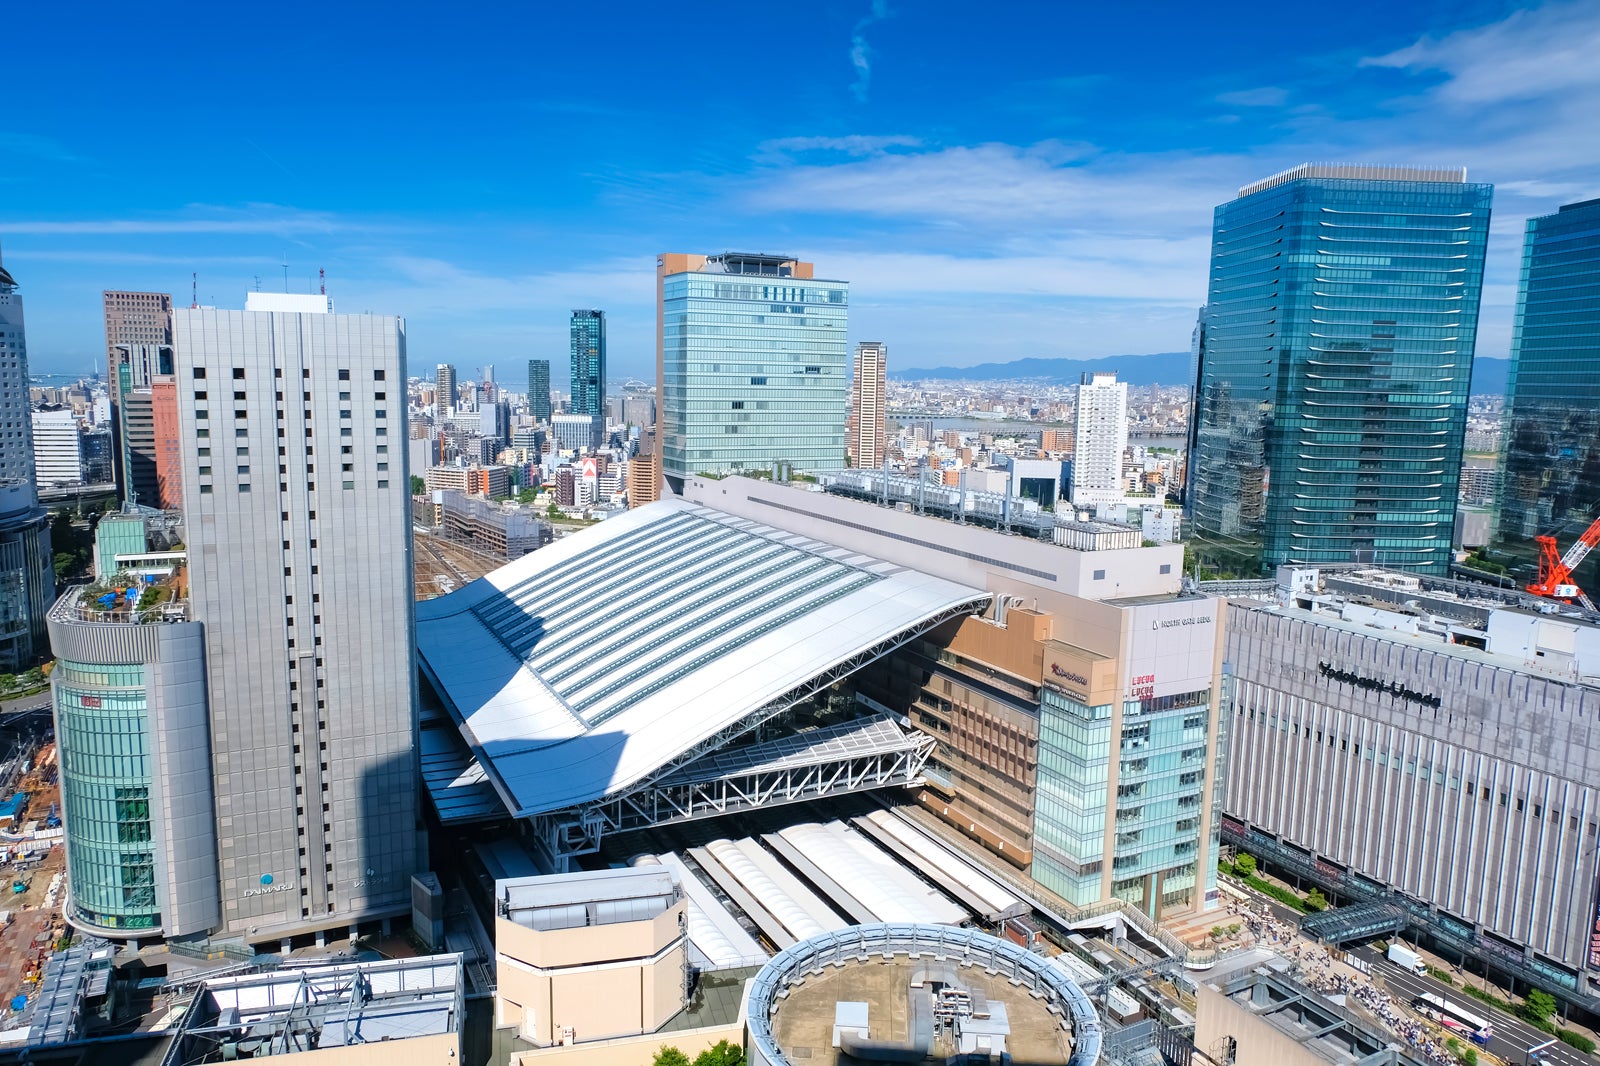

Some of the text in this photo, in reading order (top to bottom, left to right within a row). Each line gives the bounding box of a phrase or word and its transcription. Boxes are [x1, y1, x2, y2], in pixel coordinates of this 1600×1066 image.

[1132, 674, 1155, 686] LUCUA
[1131, 685, 1154, 697] LUCUA
[243, 882, 295, 898] DAIMARU
